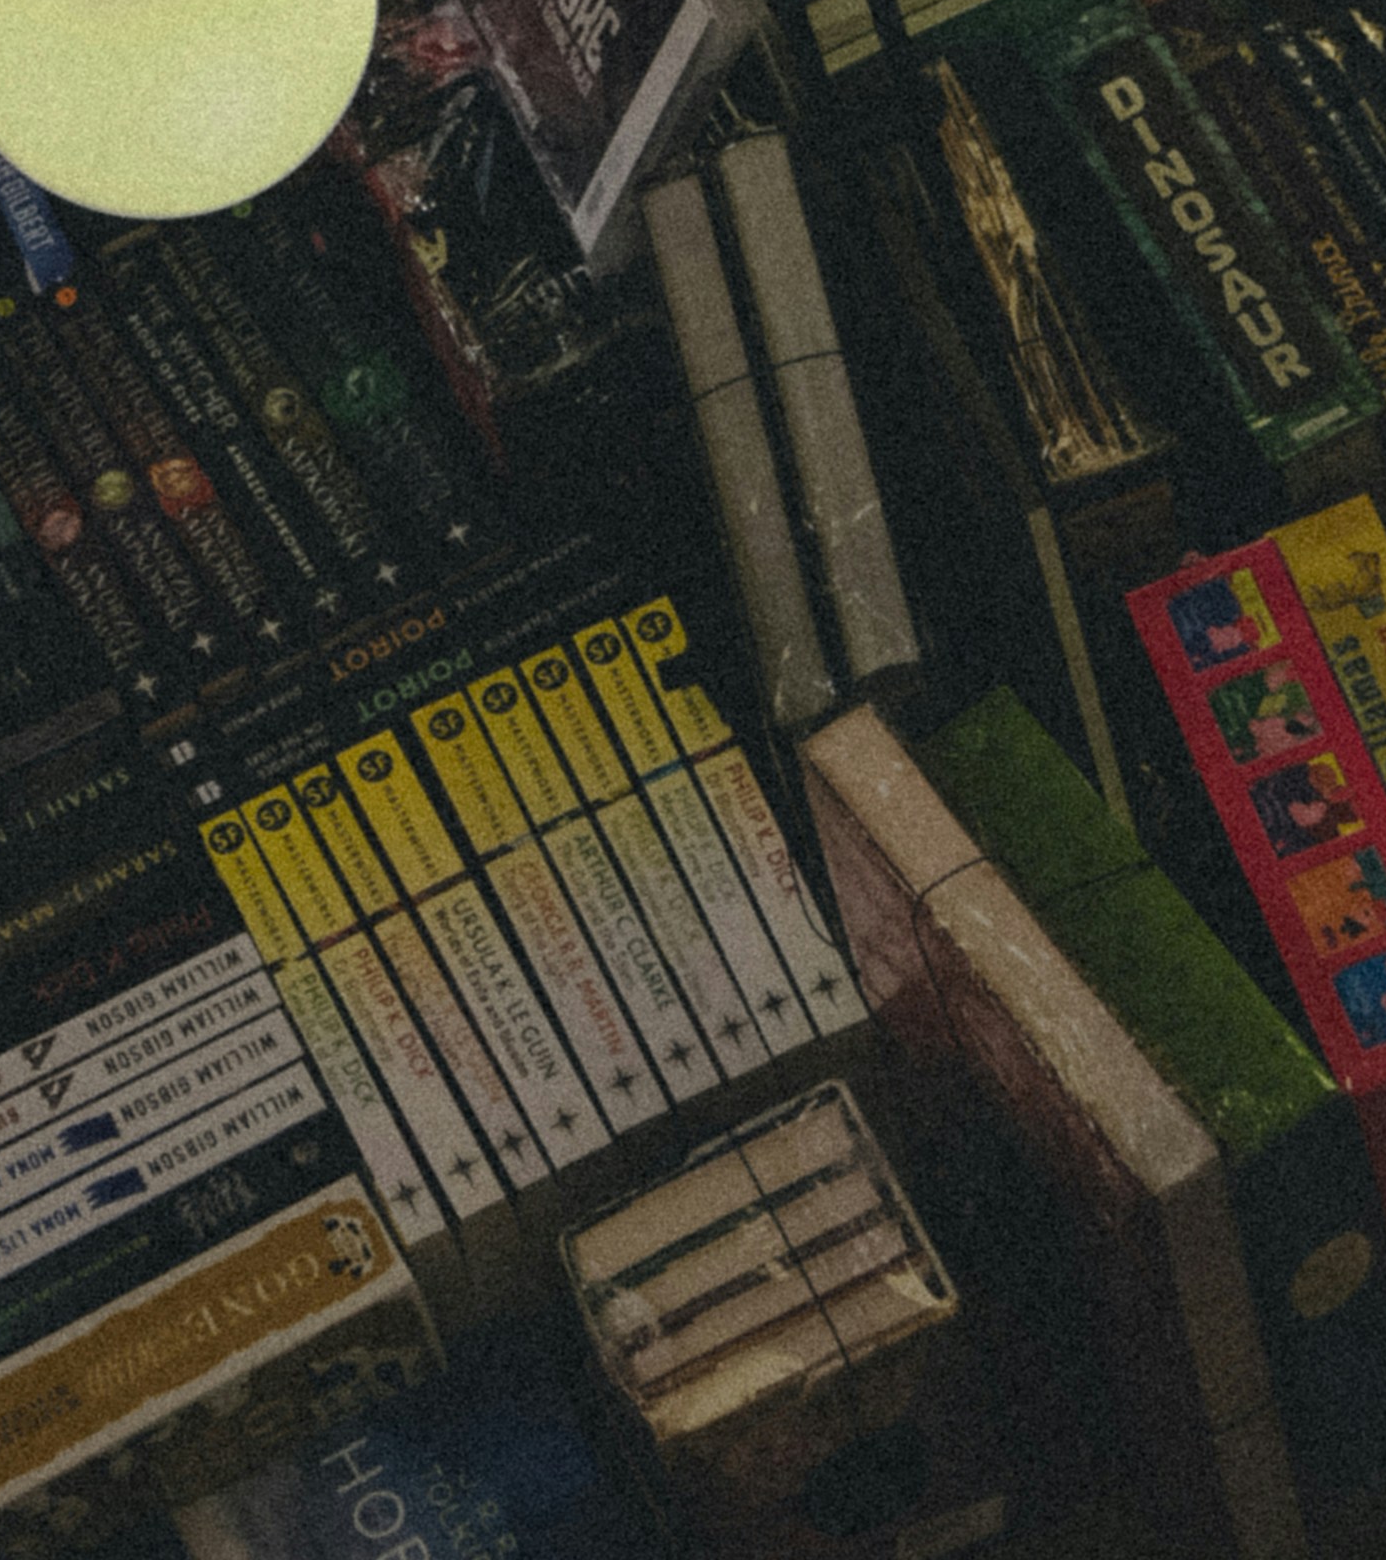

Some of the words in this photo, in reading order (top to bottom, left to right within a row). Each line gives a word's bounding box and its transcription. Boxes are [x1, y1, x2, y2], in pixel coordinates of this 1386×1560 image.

[1096, 68, 1313, 392] DINOSAUR
[1305, 226, 1386, 330] Prince
[325, 607, 448, 683] POIROT
[352, 646, 474, 721] POIROT
[571, 830, 626, 914] ARTHUR
[622, 935, 675, 1014] CLARKE
[158, 946, 242, 1001] WILLIAM
[83, 988, 156, 1038] GIBSON
[175, 984, 261, 1041] WILLIAM
[101, 1027, 174, 1077] GIBSON
[193, 1030, 278, 1087] WILLIAM
[118, 1074, 190, 1125] GIBSON
[220, 1084, 304, 1140] WILLIAM
[3, 1141, 55, 1182] MONA
[143, 1127, 217, 1179] GIBSON
[29, 1200, 81, 1240] MONA
[178, 1246, 322, 1344] GONE
